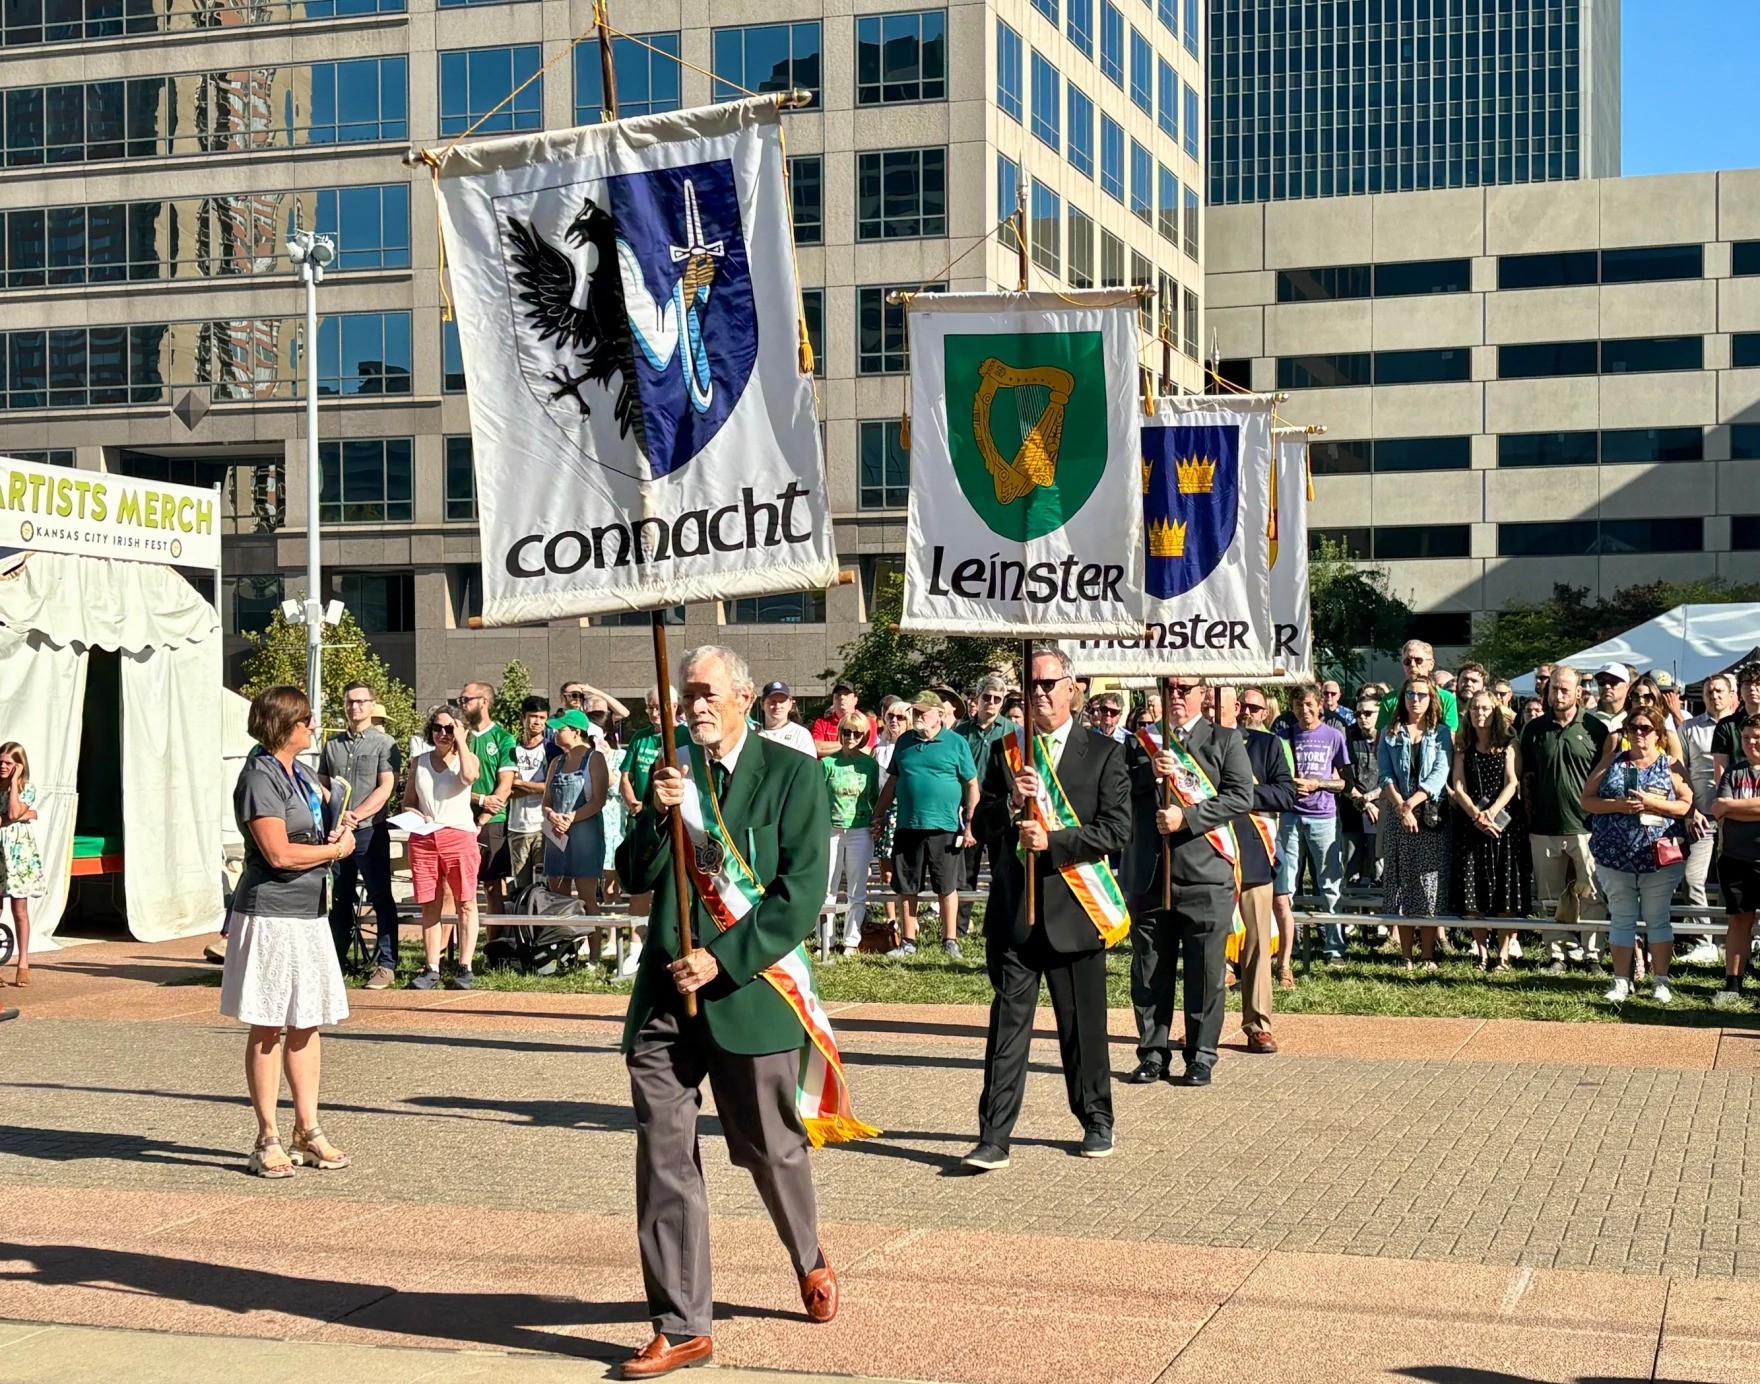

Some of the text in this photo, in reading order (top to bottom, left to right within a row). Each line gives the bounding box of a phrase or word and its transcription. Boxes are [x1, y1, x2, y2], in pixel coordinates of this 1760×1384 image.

[0, 470, 213, 536] RTISTS MERCH
[36, 526, 168, 551] KANSAS CITY IRISH FEST
[505, 481, 812, 579] connacht
[1303, 751, 1326, 763] YORK
